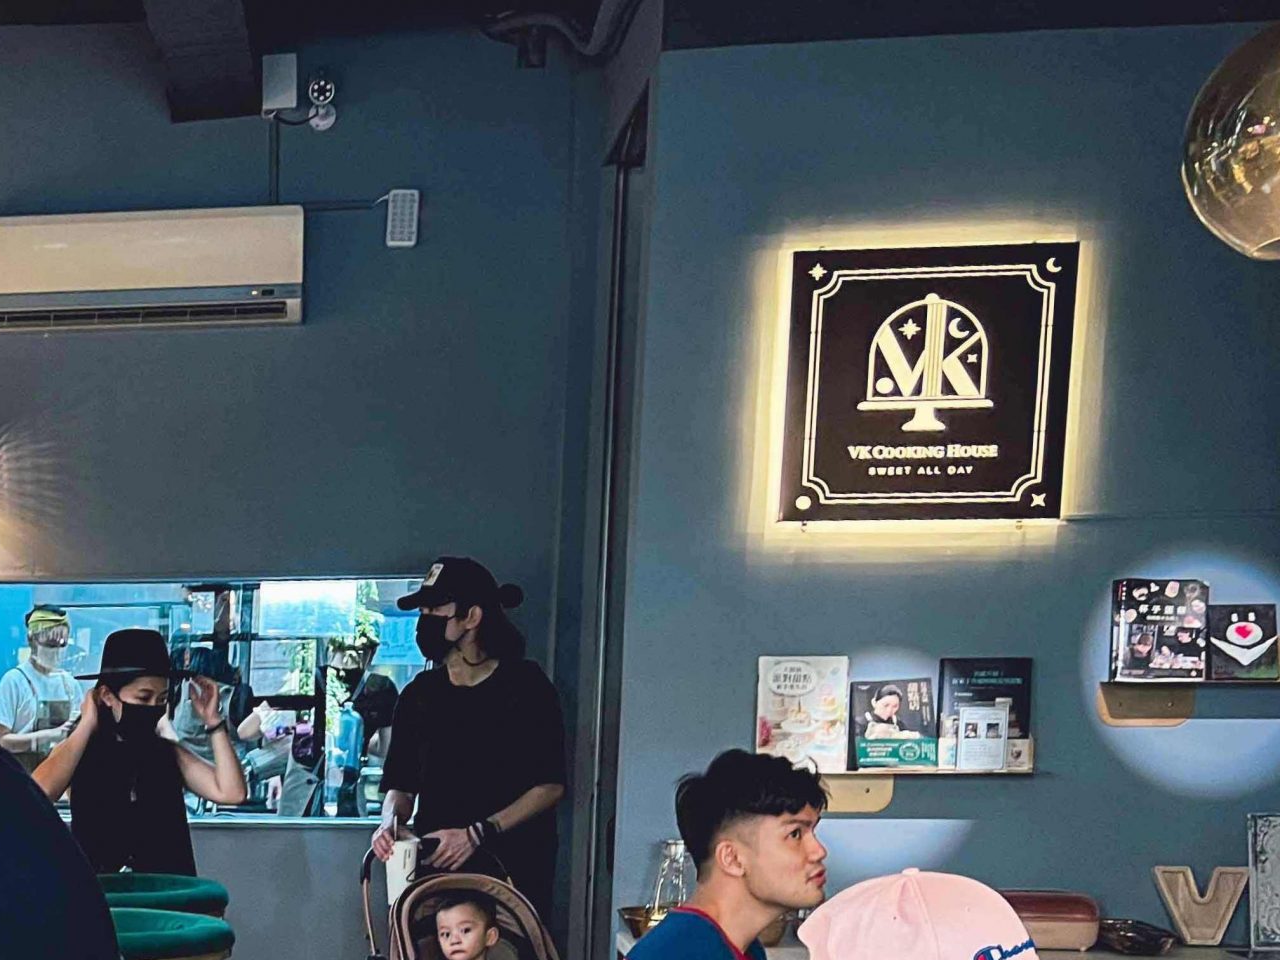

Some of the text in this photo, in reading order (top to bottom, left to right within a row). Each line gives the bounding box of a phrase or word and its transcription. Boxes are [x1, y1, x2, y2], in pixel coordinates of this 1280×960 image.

[847, 443, 998, 459] VK COOKING HOUSE
[868, 465, 973, 475] SWEET ALL DAY
